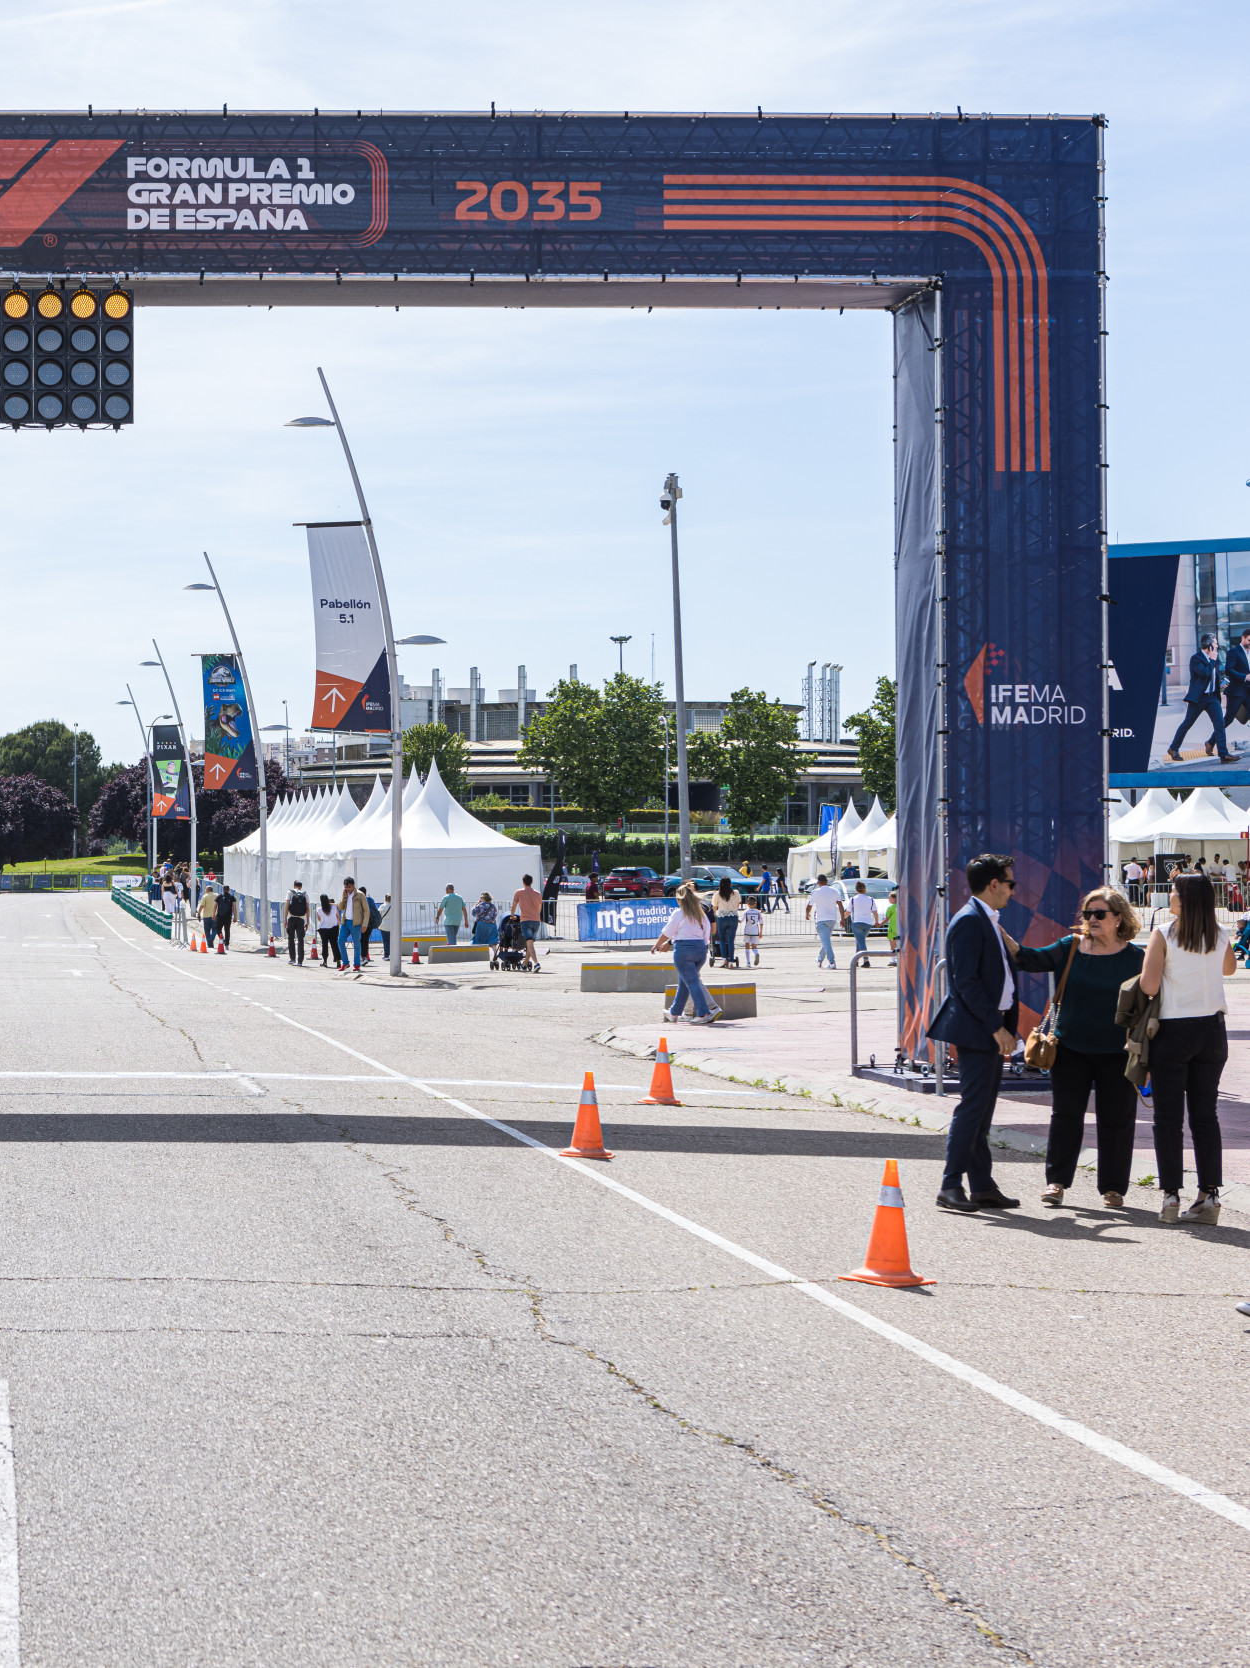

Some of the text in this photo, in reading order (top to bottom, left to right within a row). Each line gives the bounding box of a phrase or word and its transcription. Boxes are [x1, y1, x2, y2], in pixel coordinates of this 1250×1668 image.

[127, 157, 315, 179] FORMULA 1
[127, 182, 356, 205] GRAN PREMIO
[454, 180, 602, 221] 2035
[127, 206, 309, 231] DE ESPAÑA
[320, 598, 371, 609] Pabellón
[339, 613, 354, 624] 5.1
[991, 684, 1067, 703] IFEMA
[991, 706, 1087, 725] MADRID
[636, 905, 667, 916] madrid
[636, 914, 671, 925] experie
[750, 915, 756, 925] 5
